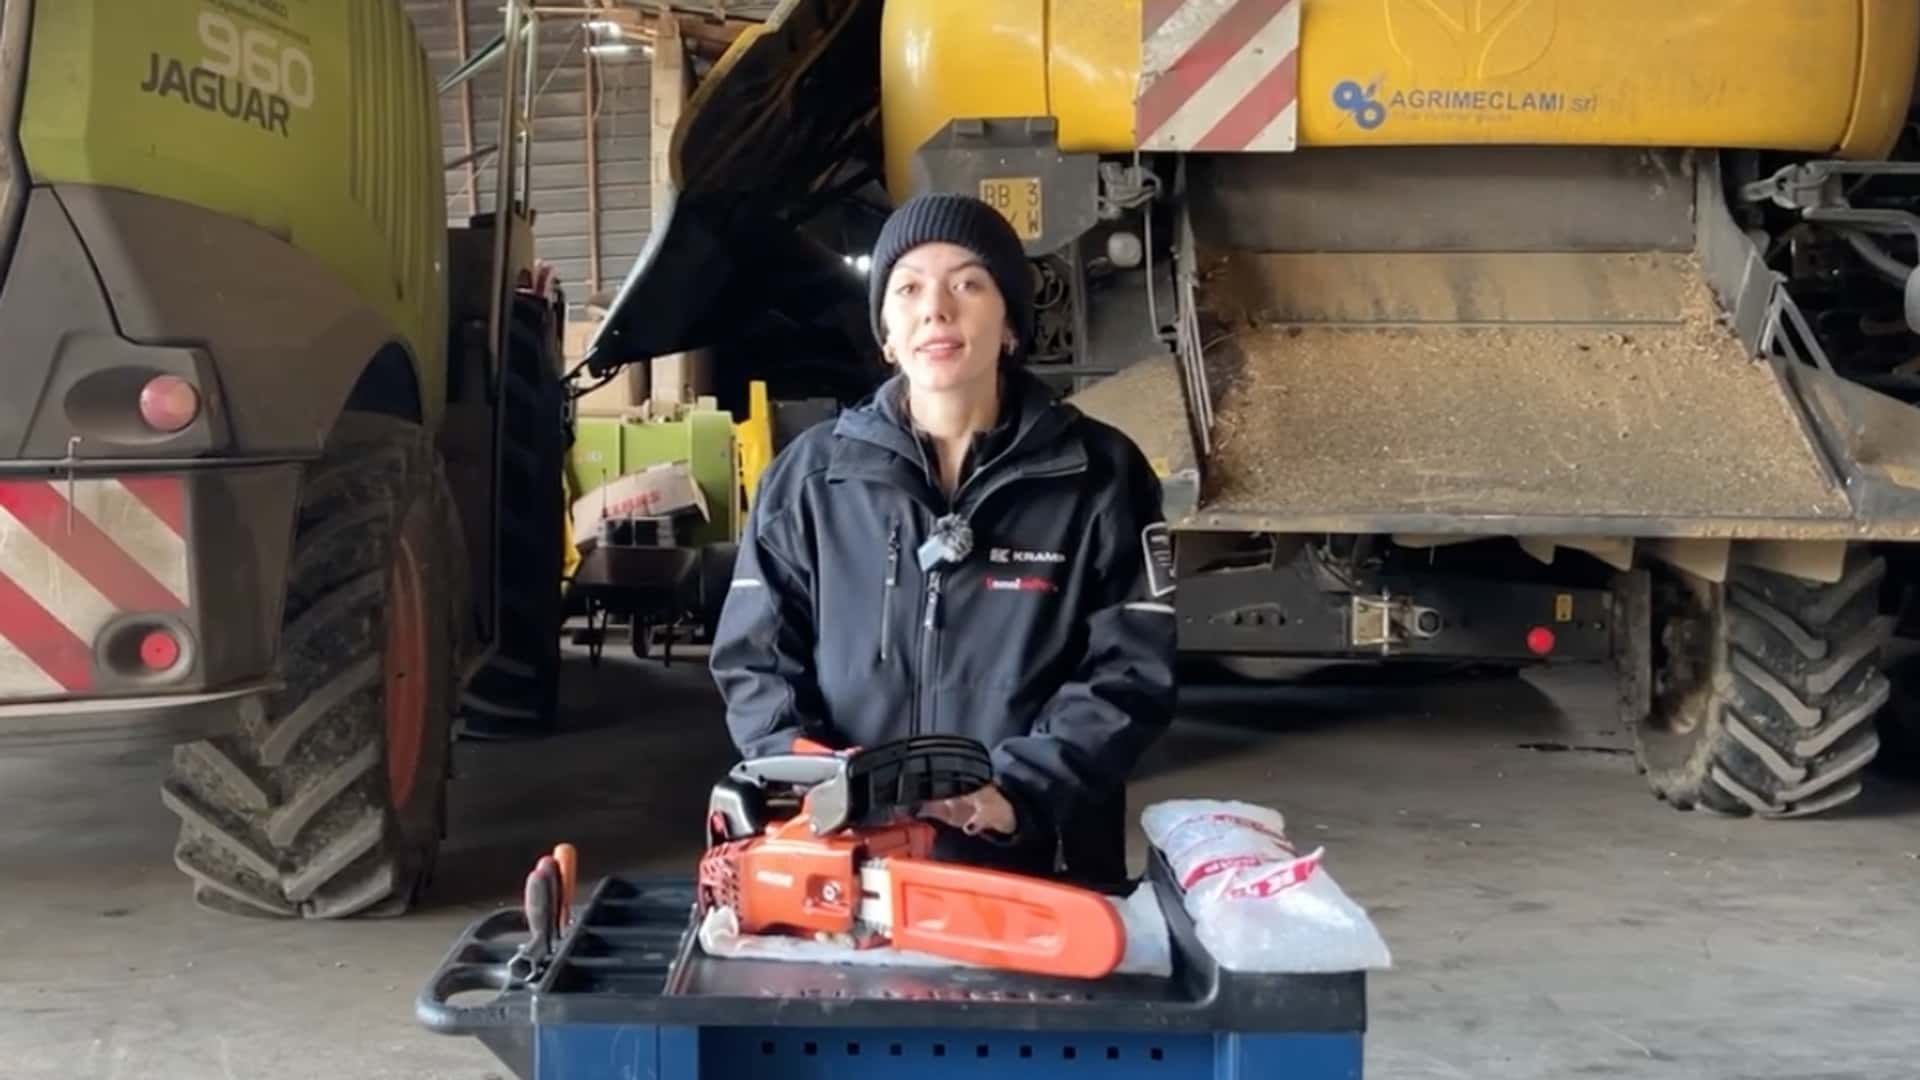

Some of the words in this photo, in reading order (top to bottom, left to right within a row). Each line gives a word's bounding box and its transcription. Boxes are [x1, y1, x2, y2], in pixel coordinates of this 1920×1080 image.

[140, 52, 289, 138] JAGUAR
[198, 11, 314, 109] 960
[1389, 89, 1564, 112] AGRIMECLAMI
